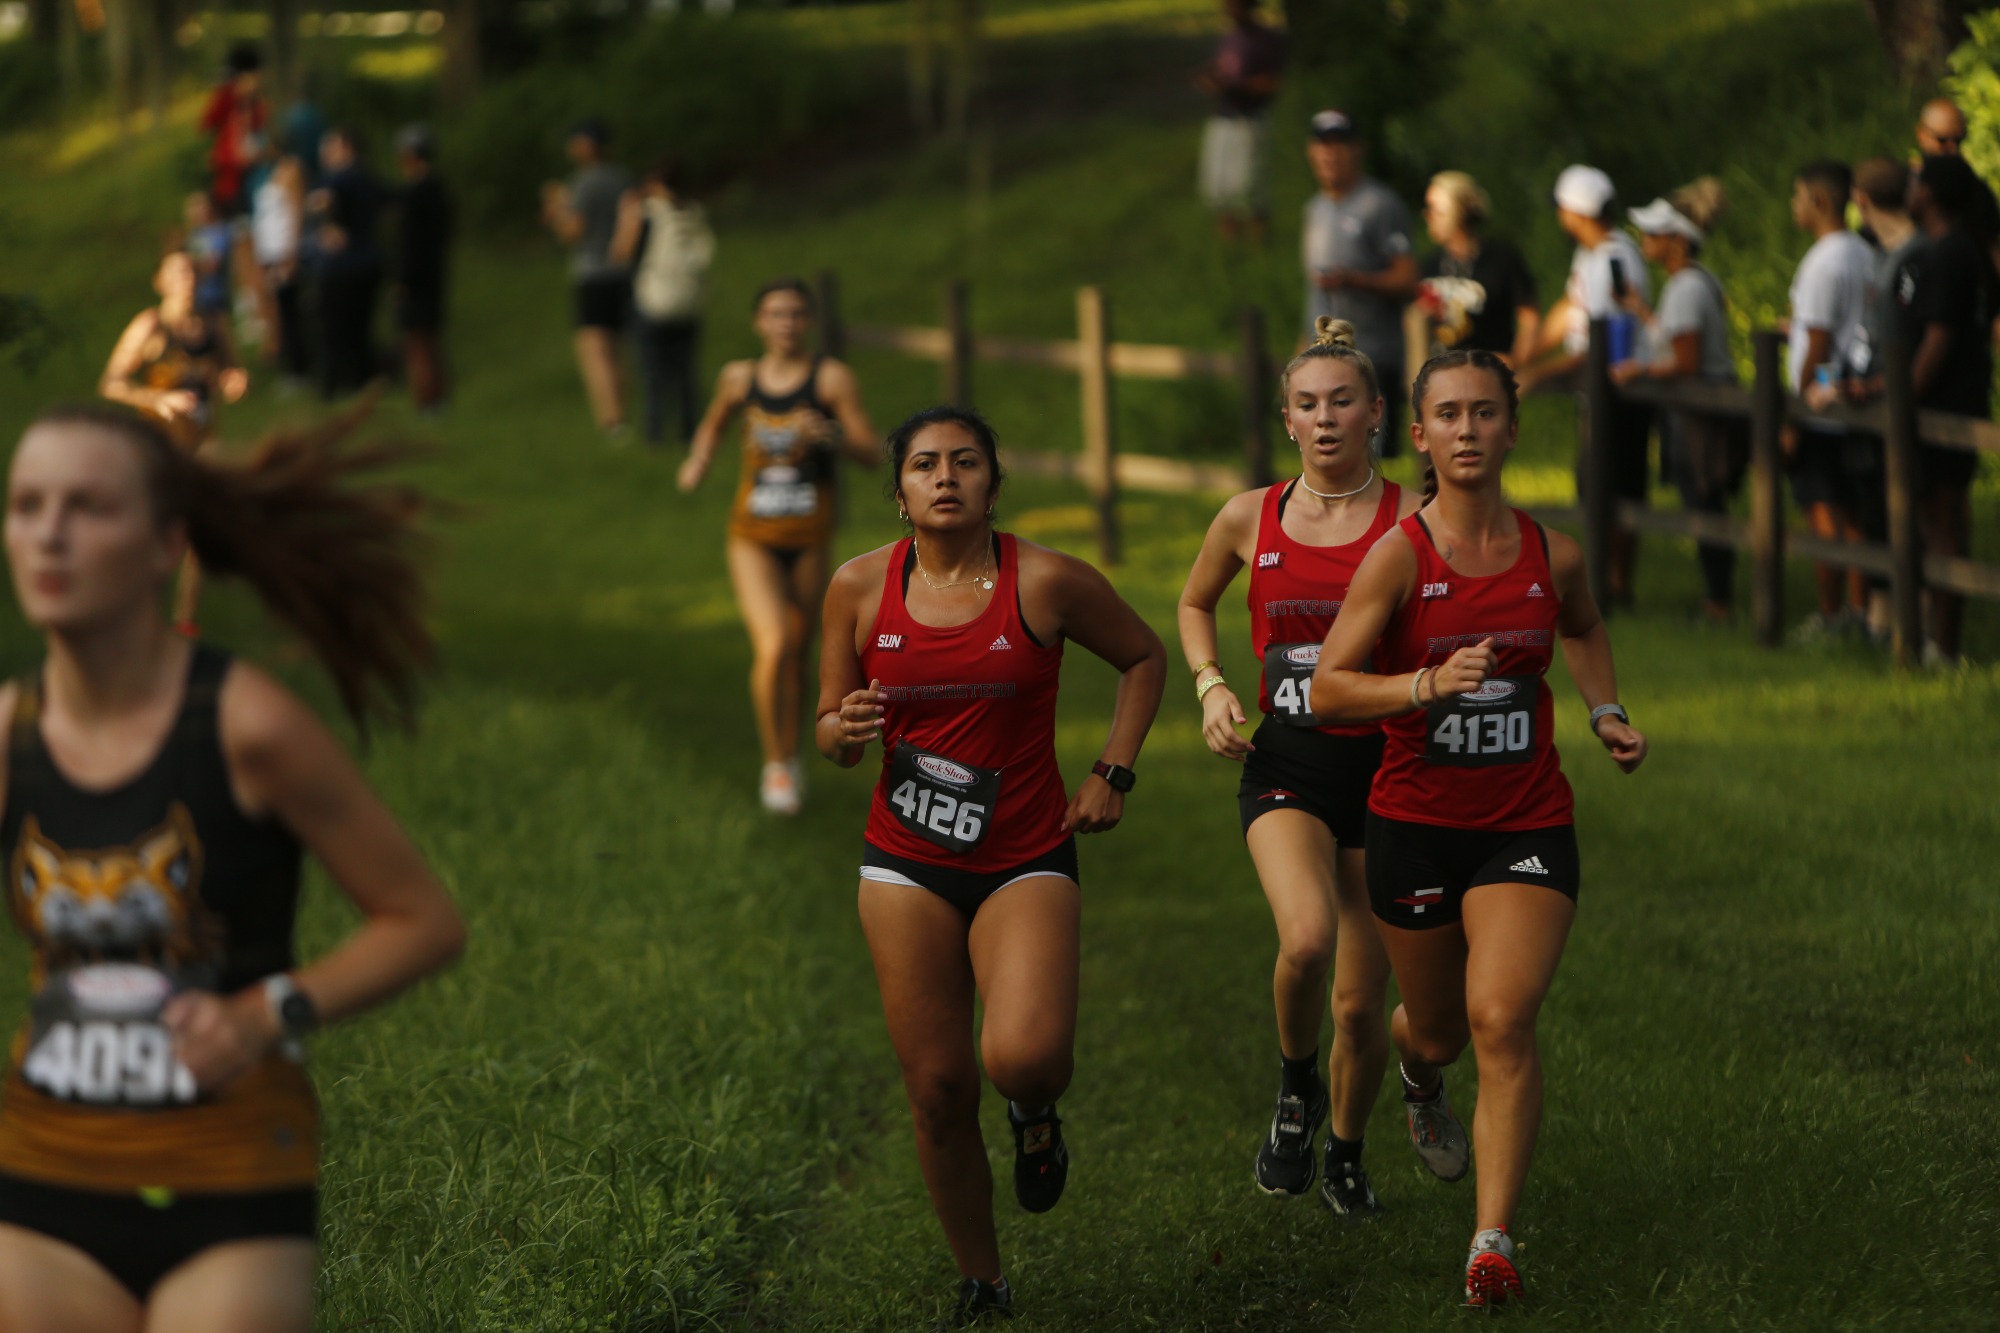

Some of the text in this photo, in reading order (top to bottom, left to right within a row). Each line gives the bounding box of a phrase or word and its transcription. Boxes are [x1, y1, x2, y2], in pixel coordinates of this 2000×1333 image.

[1434, 710, 1530, 753] 4130
[917, 755, 943, 773] Track
[943, 766, 975, 783] Shack
[891, 779, 985, 842] 4126
